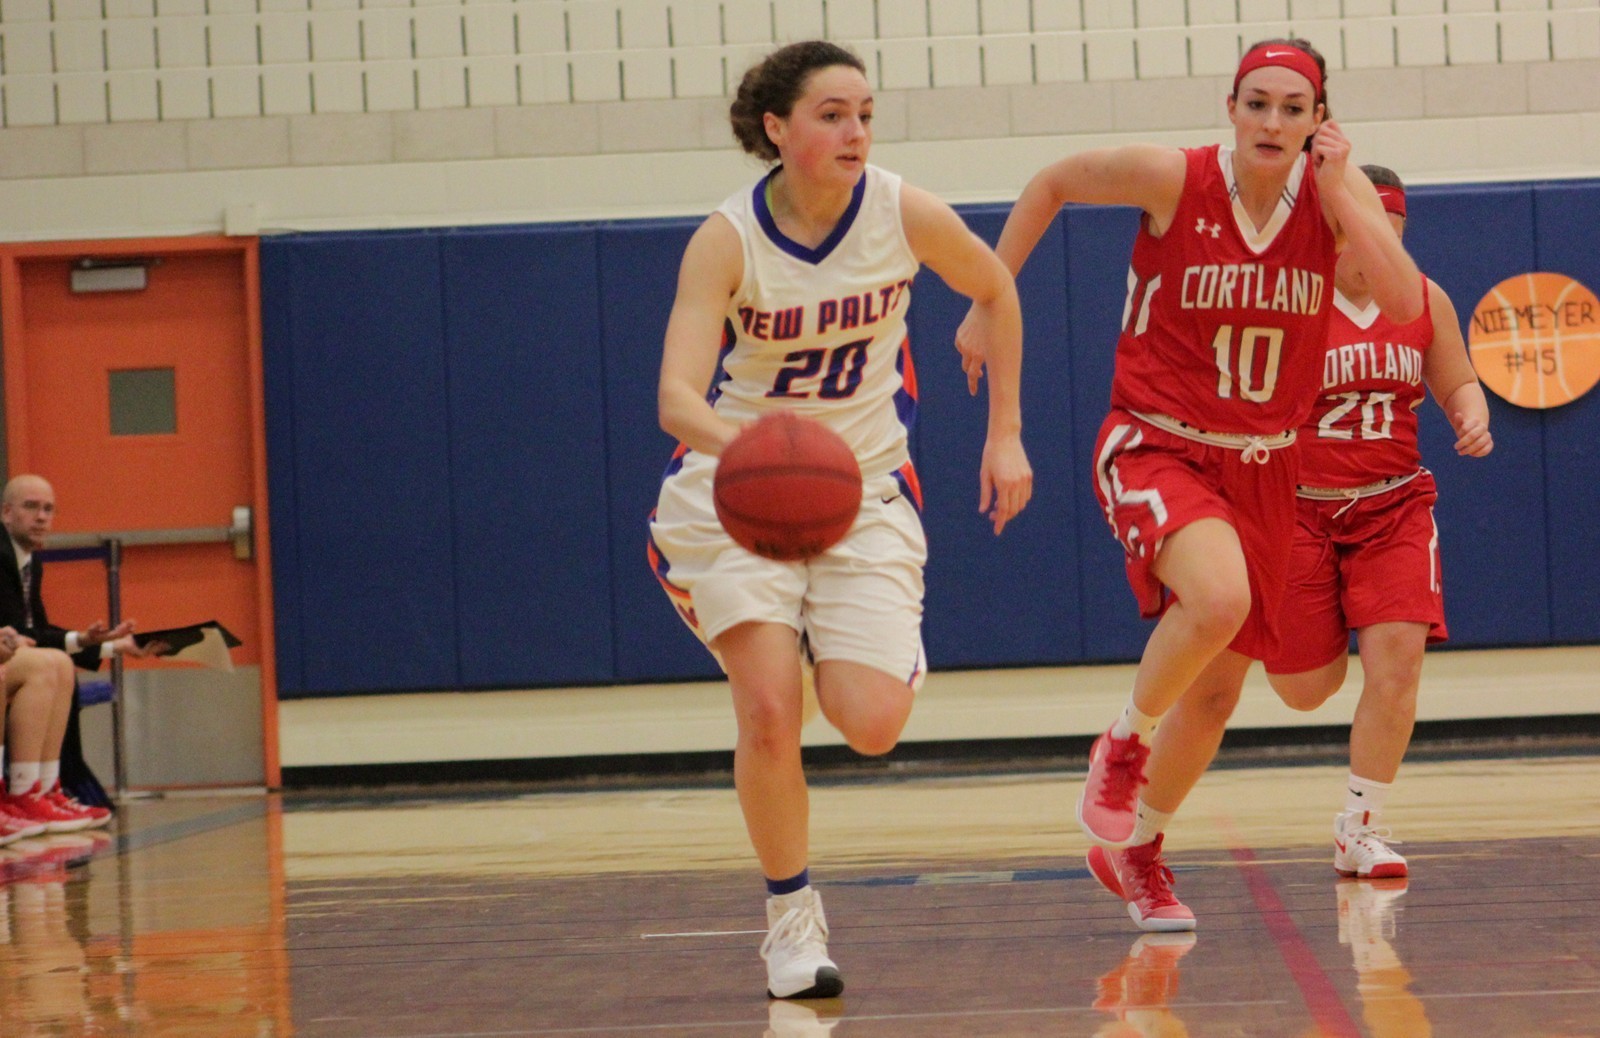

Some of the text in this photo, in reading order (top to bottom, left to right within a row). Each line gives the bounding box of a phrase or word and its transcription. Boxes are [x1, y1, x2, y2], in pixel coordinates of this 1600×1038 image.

[1181, 264, 1324, 316] CORTLAND
[1473, 301, 1595, 336] NIEMEYER
[764, 336, 875, 400] 20
[1212, 324, 1284, 403] 10
[1319, 342, 1422, 389] ORTLAND
[1504, 349, 1557, 376] #45
[1317, 391, 1396, 440] 20
